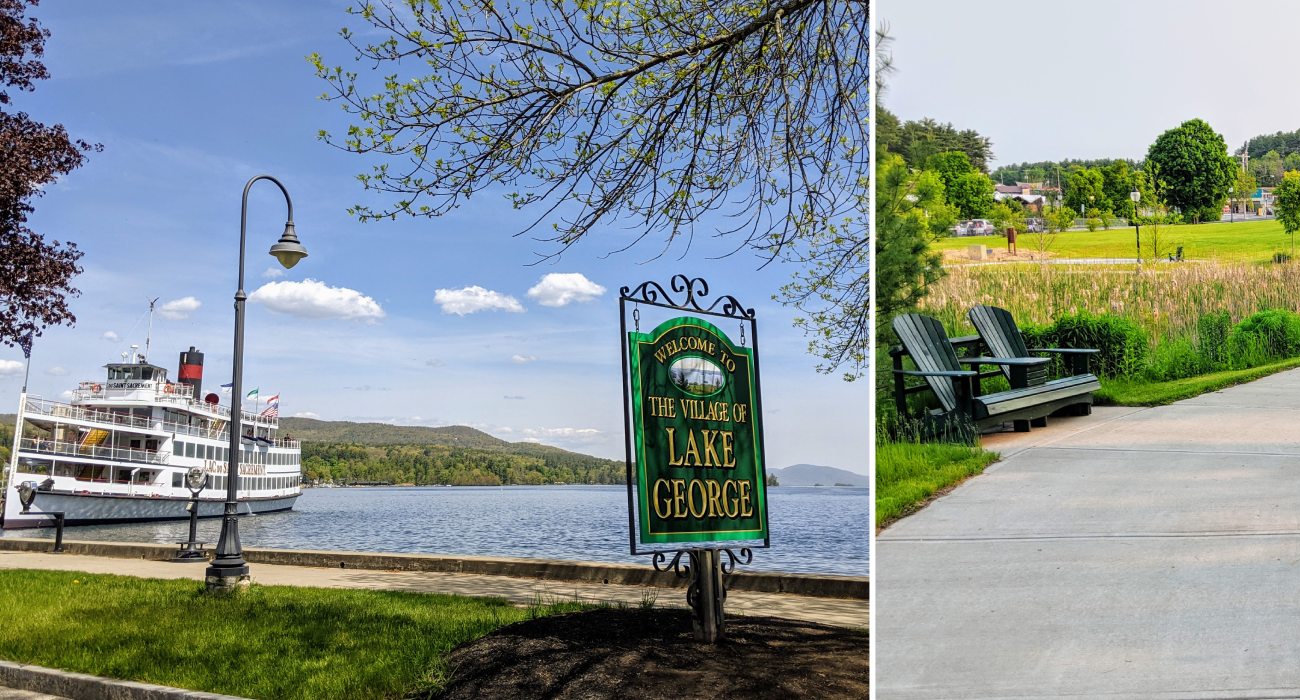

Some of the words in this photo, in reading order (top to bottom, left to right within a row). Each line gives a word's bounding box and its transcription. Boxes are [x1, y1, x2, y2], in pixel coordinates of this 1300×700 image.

[654, 336, 716, 364] WELCOME
[720, 351, 736, 373] TO
[648, 396, 676, 418] THE
[680, 399, 730, 423] VILLAGE
[732, 403, 748, 423] OF
[665, 427, 737, 469] LAKE
[652, 478, 754, 519] GEORGE
